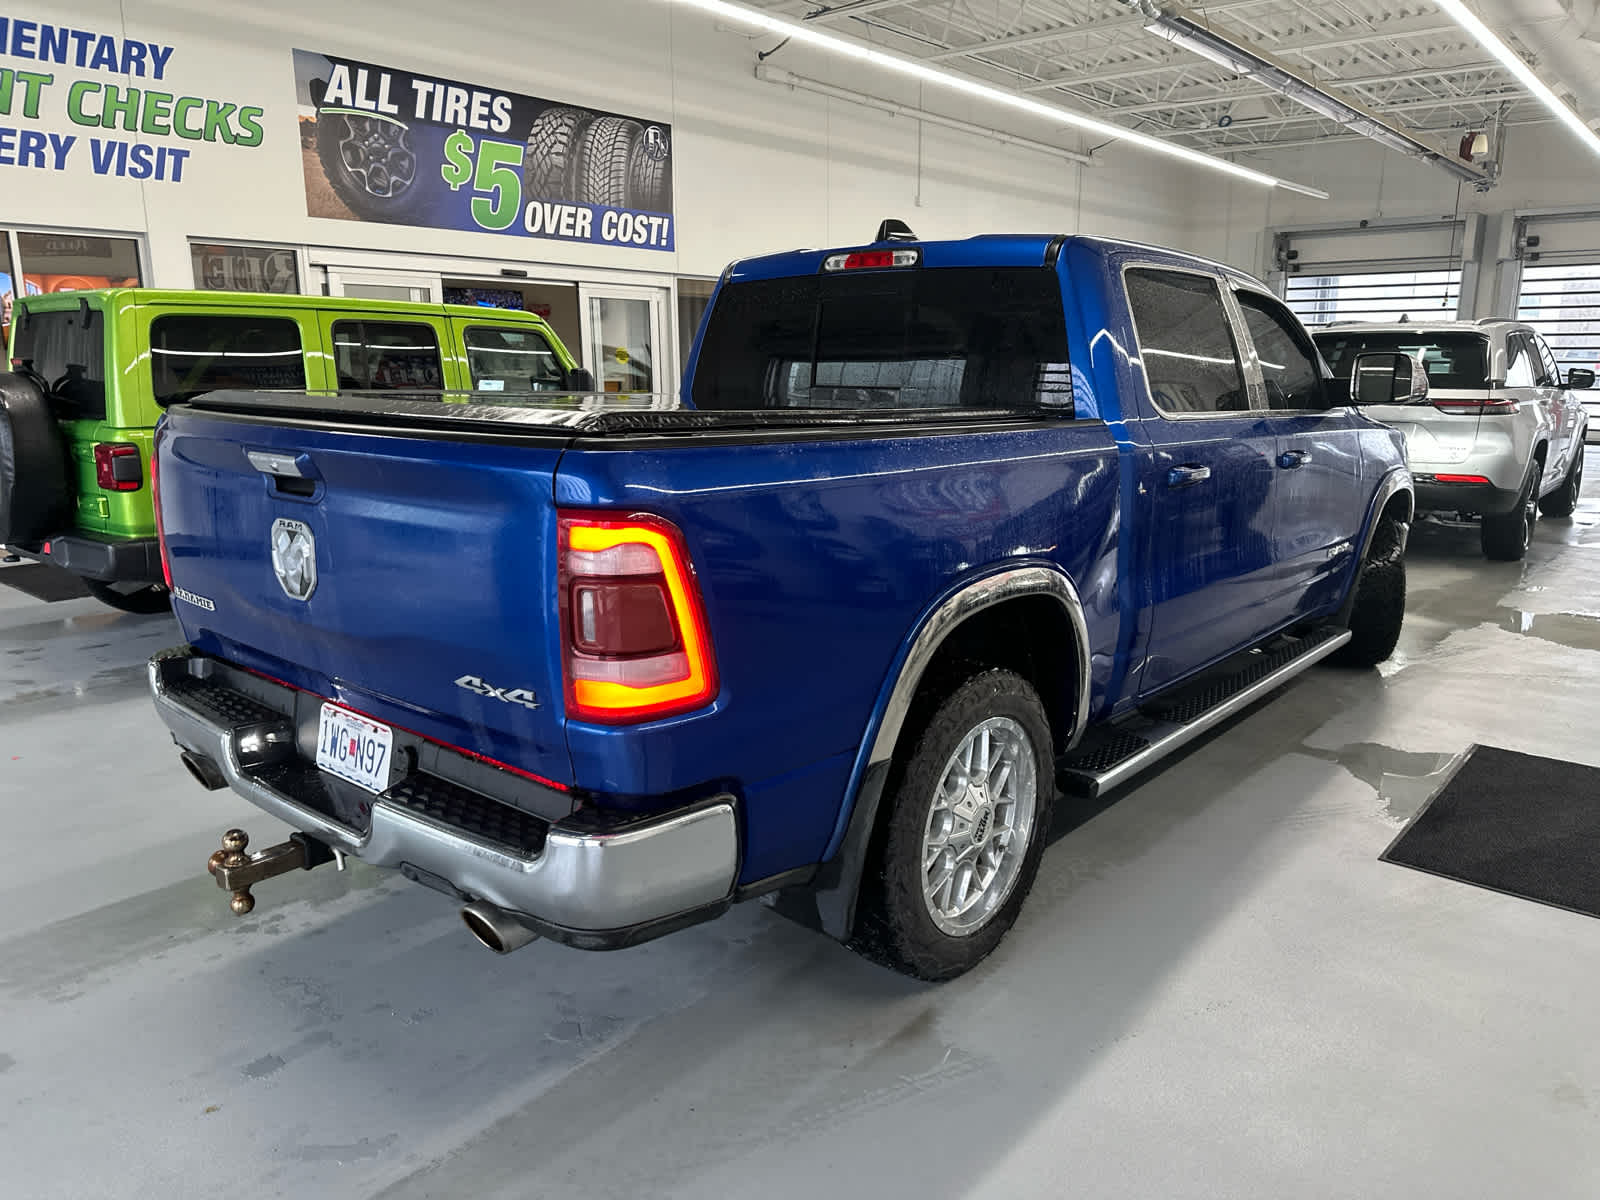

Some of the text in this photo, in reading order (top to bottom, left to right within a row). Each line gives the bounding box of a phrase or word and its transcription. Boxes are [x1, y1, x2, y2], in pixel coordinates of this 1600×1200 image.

[0, 17, 174, 80] ENTARY
[67, 80, 264, 147] CHECKS
[323, 64, 512, 132] ALL TIRES
[90, 139, 190, 182] VISIT
[441, 130, 525, 230] $5
[524, 201, 669, 247] OVER COST!
[279, 519, 303, 531] RAM
